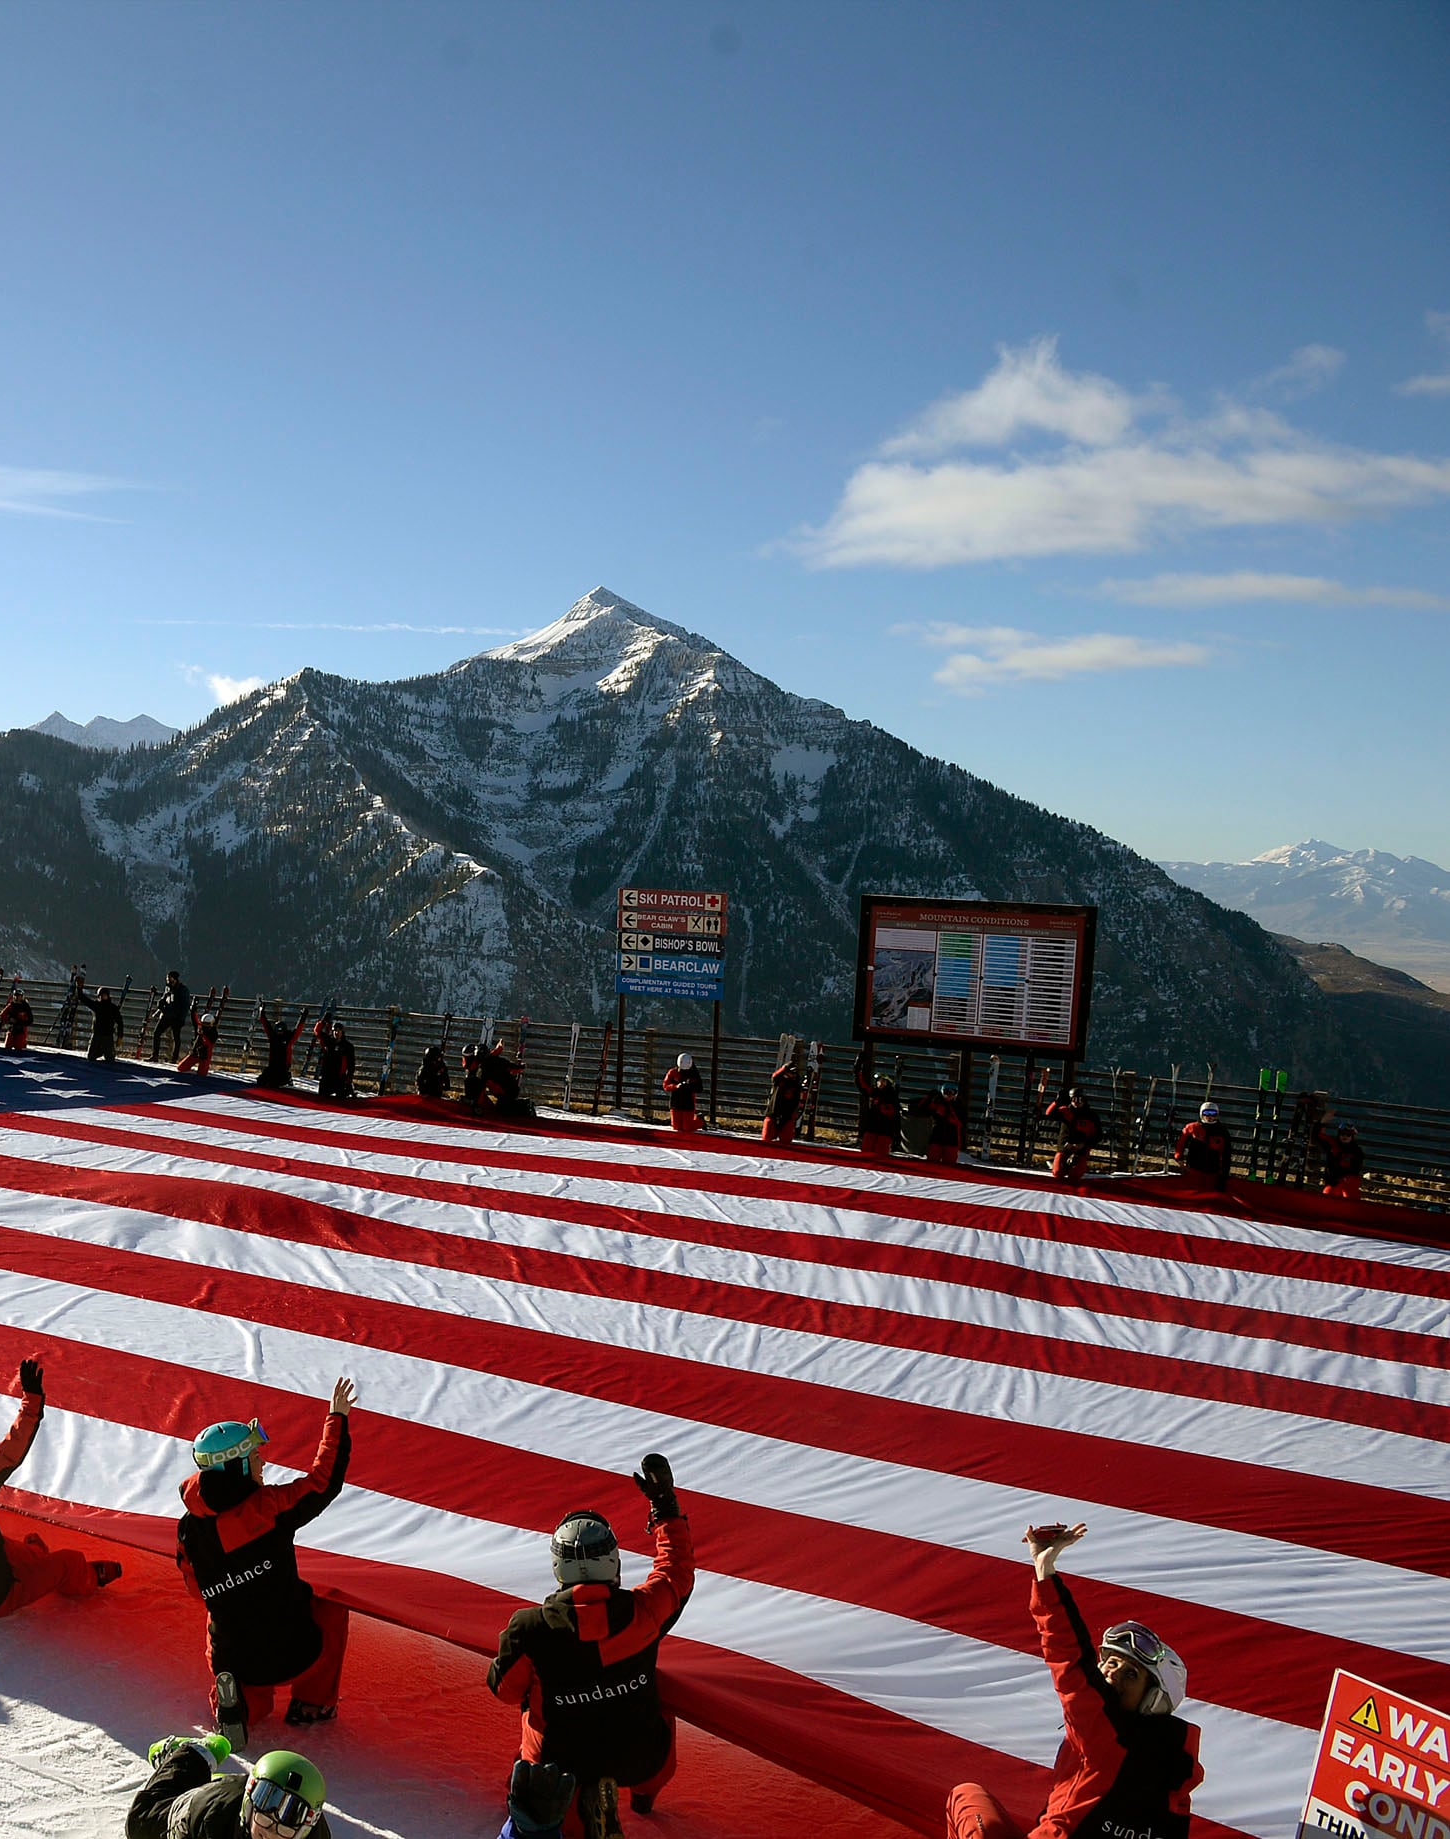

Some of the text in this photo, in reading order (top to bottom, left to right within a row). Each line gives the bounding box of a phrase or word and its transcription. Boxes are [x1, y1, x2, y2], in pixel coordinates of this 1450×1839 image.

[639, 893, 704, 907] SKI PATROL
[658, 915, 686, 923] CLAW'S
[919, 913, 1030, 927] MOUNTAIN CONDITIONS
[654, 938, 721, 953] BISHOP'S BOWL
[654, 959, 720, 974] BEARCLAW
[621, 977, 671, 986] COMPLIMENTARY
[697, 982, 717, 990] TOURS
[212, 1438, 252, 1464] POC
[201, 1559, 273, 1600] sundance
[555, 1673, 648, 1706] sundance
[1329, 1728, 1450, 1807] EARLY
[1345, 1780, 1450, 1839] COND
[1101, 1820, 1164, 1839] sund
